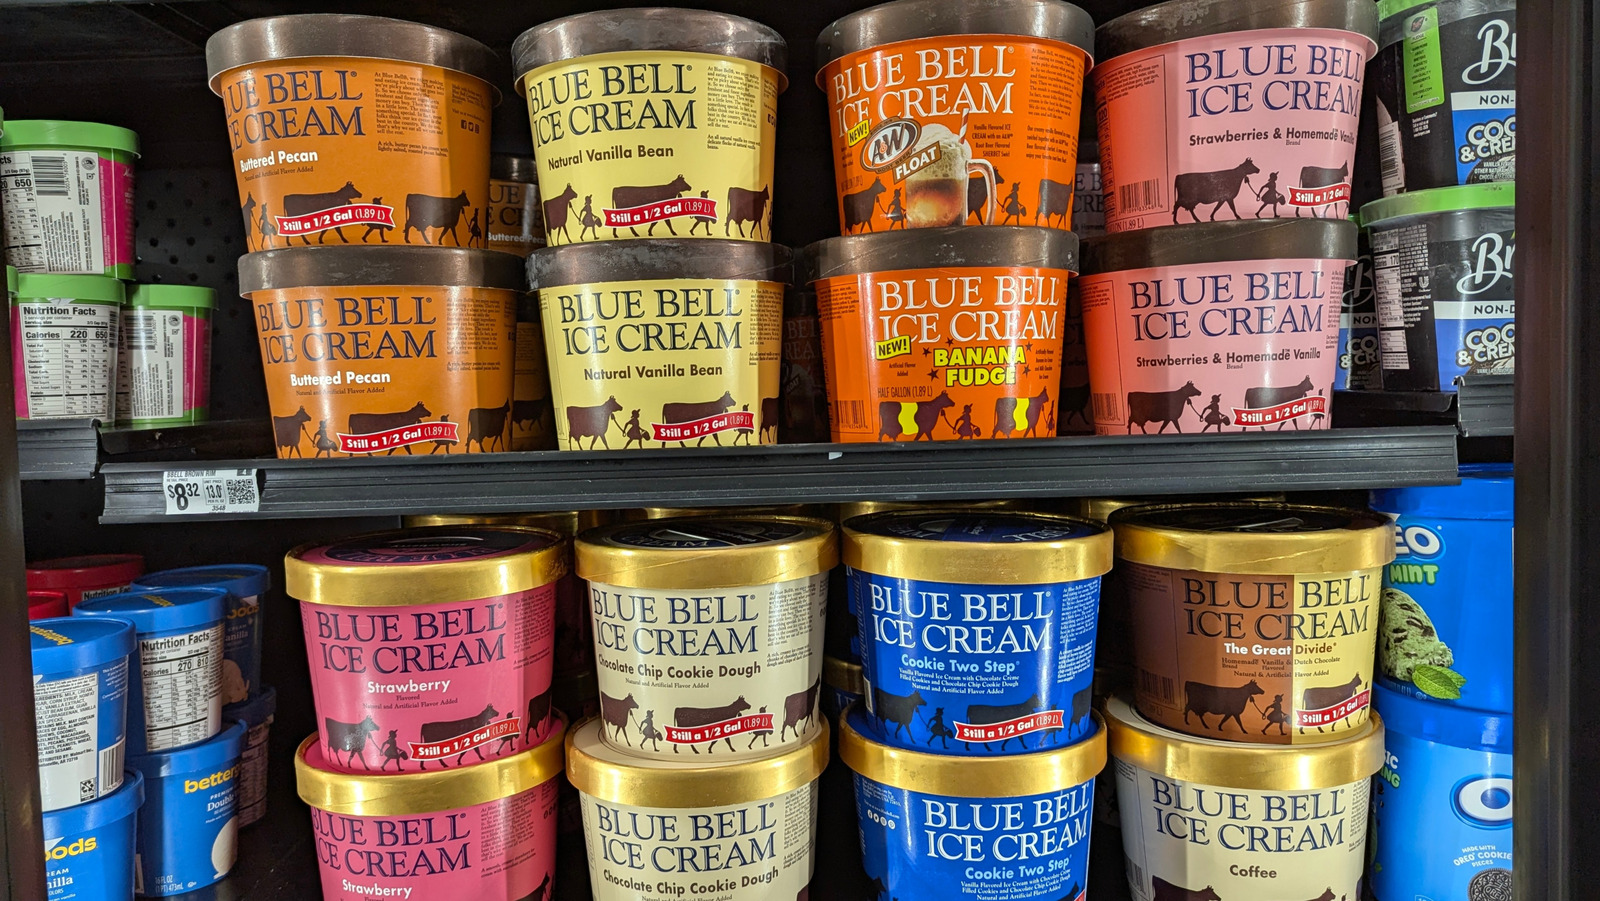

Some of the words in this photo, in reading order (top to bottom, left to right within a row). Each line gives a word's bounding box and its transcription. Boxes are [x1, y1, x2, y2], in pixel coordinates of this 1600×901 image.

[833, 54, 906, 104] BLUE
[1185, 45, 1297, 84] BLUE
[529, 69, 592, 116] BLUE
[1188, 82, 1254, 118] ICE
[1262, 80, 1360, 118] CREAM
[243, 106, 366, 144] CREAM
[534, 111, 565, 148] ICE
[568, 99, 698, 135] CREAM
[837, 98, 872, 138] ICE
[878, 82, 1014, 122] CREAM
[849, 124, 868, 142] NEW!
[870, 121, 907, 166] A&W
[1189, 129, 1269, 147] Strawberries
[1273, 130, 1282, 139] &
[240, 151, 275, 172] Buttered
[278, 151, 318, 164] Pecan
[548, 153, 583, 170] Natural
[586, 145, 632, 162] Vanilla
[638, 145, 674, 158] Bean
[895, 148, 938, 180] FLOAT
[558, 291, 645, 323] BLUE
[878, 276, 983, 311] BLUE
[1129, 274, 1234, 310] BLUE
[73, 307, 96, 315] Facts
[258, 298, 327, 332] BLUE
[879, 312, 941, 343] ICE
[950, 310, 1057, 342] CREAM
[1132, 310, 1192, 342] ICE
[1199, 304, 1323, 337] CREAM
[263, 334, 297, 364] ICE
[302, 330, 437, 361] CREAM
[563, 326, 610, 355] ICE
[616, 321, 742, 352] CREAM
[878, 338, 907, 356] NEW!
[584, 365, 630, 381] Natural
[635, 364, 684, 378] Vanilla
[691, 364, 722, 376] Bean
[934, 347, 1025, 367] BANANA
[1136, 354, 1208, 367] Strawberries
[1213, 353, 1222, 363] &
[1293, 347, 1320, 359] Vanilla
[290, 374, 341, 386] Buttered
[346, 371, 390, 383] Pecan
[878, 387, 889, 398] HALF
[891, 386, 911, 397] GALLON
[912, 386, 926, 397] (1.89
[946, 366, 1016, 386] FUDGE
[592, 587, 658, 624] BLUE
[869, 582, 951, 621] BLUE
[1181, 578, 1289, 609] BLUE
[315, 610, 402, 642] BLUE
[595, 619, 628, 651] ICE
[633, 625, 758, 657] CREAM
[872, 613, 915, 649] ICE
[922, 623, 1052, 654] CREAM
[1184, 608, 1246, 639] ICE
[1255, 605, 1369, 641] CREAM
[142, 637, 185, 651] Nutrition
[188, 632, 209, 644] Facts
[320, 643, 366, 674] ICE
[372, 634, 506, 674] CREAM
[1224, 643, 1248, 654] The
[1252, 645, 1292, 656] Great
[144, 668, 169, 676] Calories
[178, 661, 191, 671] 270
[197, 657, 208, 667] 810
[598, 654, 634, 675] Chocolate
[637, 664, 663, 680] Chip
[668, 664, 714, 679] Cookie
[719, 661, 761, 680] Dough
[899, 667, 913, 675] Vanilla
[901, 654, 945, 670] Cookie
[949, 660, 979, 672] Two
[368, 680, 450, 695] Strawberry
[912, 676, 930, 684] Cookies
[672, 730, 692, 741] Still
[704, 727, 721, 738] 1/2
[724, 722, 741, 734] Gal
[1150, 776, 1251, 820] BLUE
[596, 803, 680, 841] BLUE
[922, 799, 1024, 831] BLUE
[1153, 806, 1210, 845] ICE
[1217, 818, 1344, 852] CREAM
[601, 834, 645, 870] ICE
[651, 832, 776, 873] CREAM
[925, 830, 985, 862] ICE
[992, 811, 1088, 861] CREAM
[604, 869, 652, 893] Chocolate
[656, 883, 685, 897] Chip
[691, 880, 737, 894] Cookie
[741, 866, 779, 888] Dough
[965, 866, 1014, 880] Cookie
[1019, 865, 1044, 877] Two
[1230, 865, 1277, 878] Coffee
[343, 879, 412, 899] Strawberry
